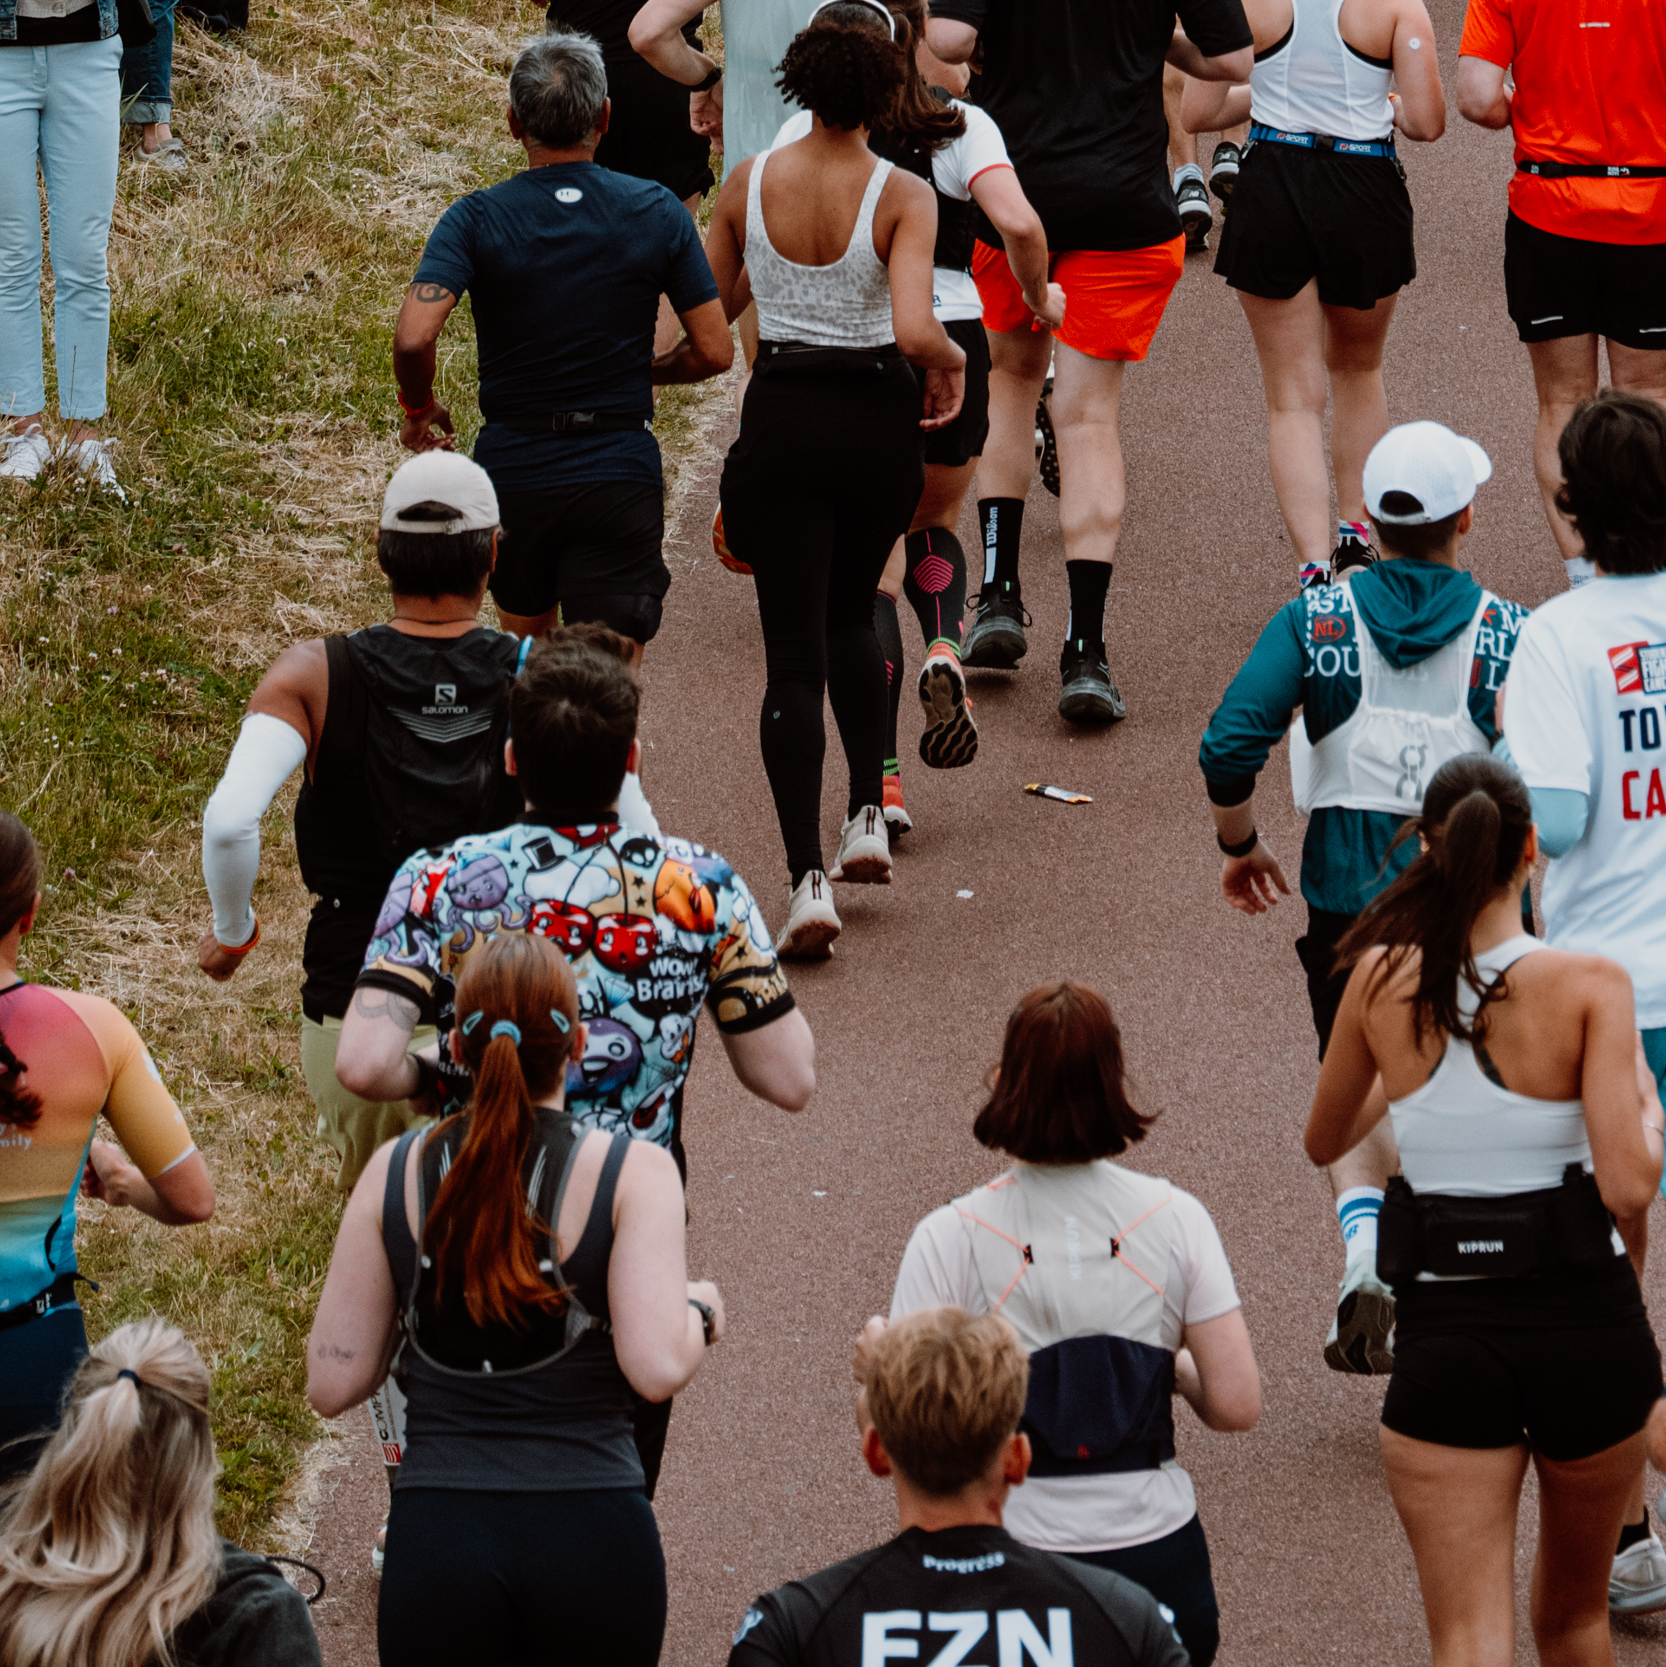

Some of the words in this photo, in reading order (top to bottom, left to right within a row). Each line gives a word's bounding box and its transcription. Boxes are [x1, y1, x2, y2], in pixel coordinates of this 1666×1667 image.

[986, 506, 998, 547] Wilson
[1314, 621, 1339, 636] NL
[422, 705, 469, 715] salomon
[1619, 709, 1660, 752] TO
[1457, 1240, 1505, 1255] KIPRUN
[923, 1552, 1006, 1574] Progress
